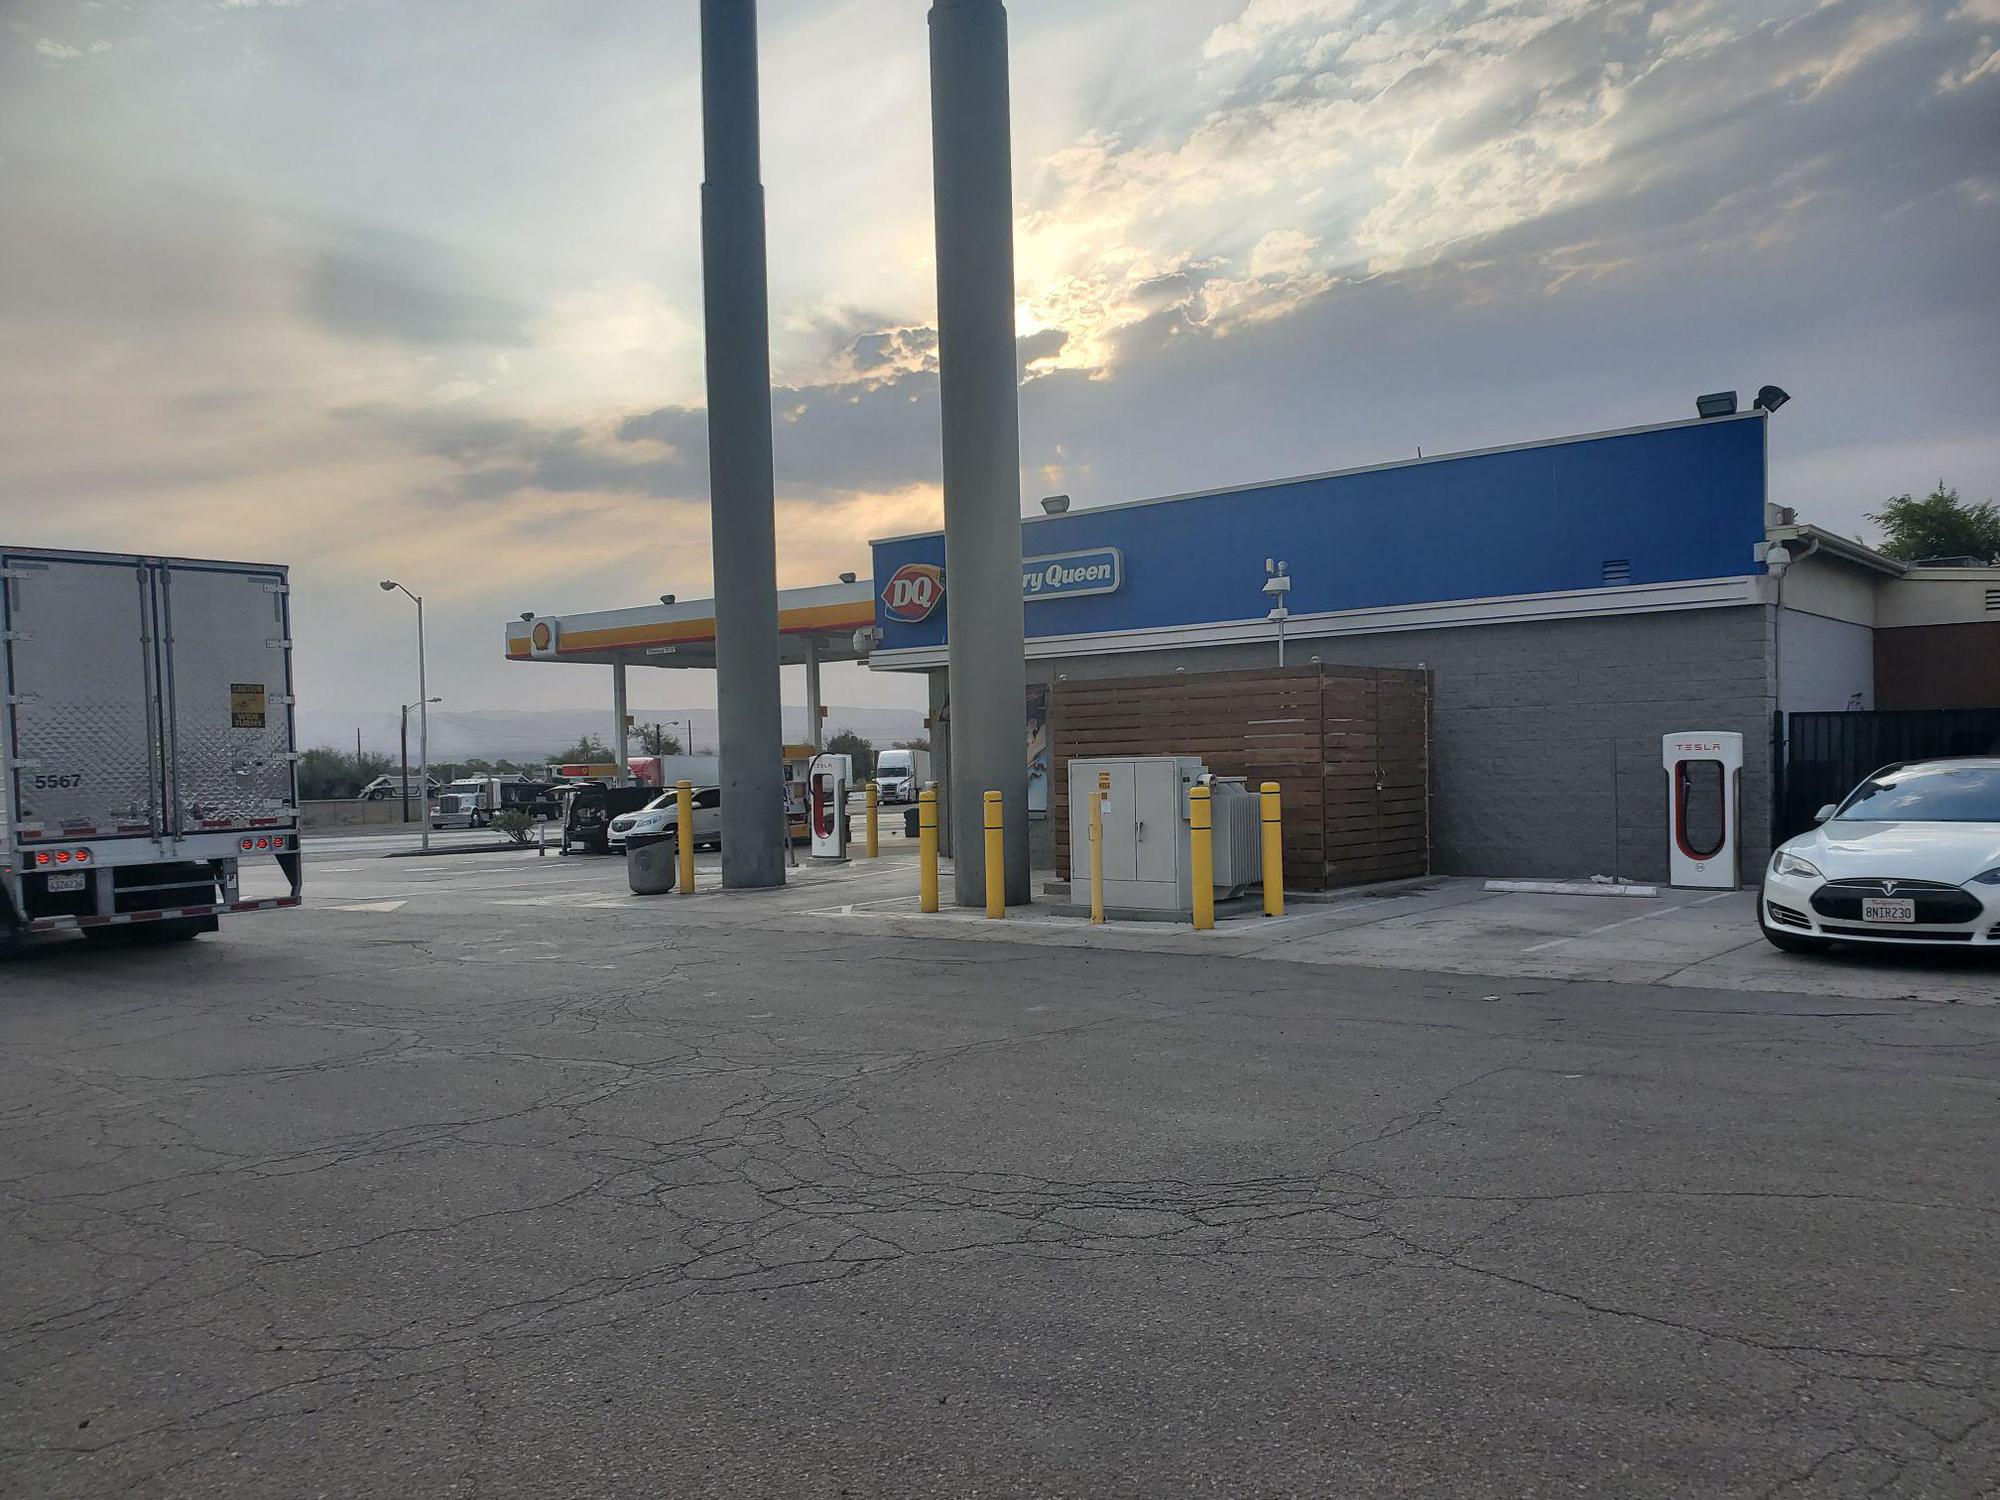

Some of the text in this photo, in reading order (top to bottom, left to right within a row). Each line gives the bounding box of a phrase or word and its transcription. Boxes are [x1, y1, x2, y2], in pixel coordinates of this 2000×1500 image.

[1023, 564, 1111, 592] ry Queen
[893, 576, 932, 607] DQ
[1675, 743, 1721, 751] TESLA
[35, 774, 81, 789] 5567
[1866, 907, 1911, 919] 8NIR230
